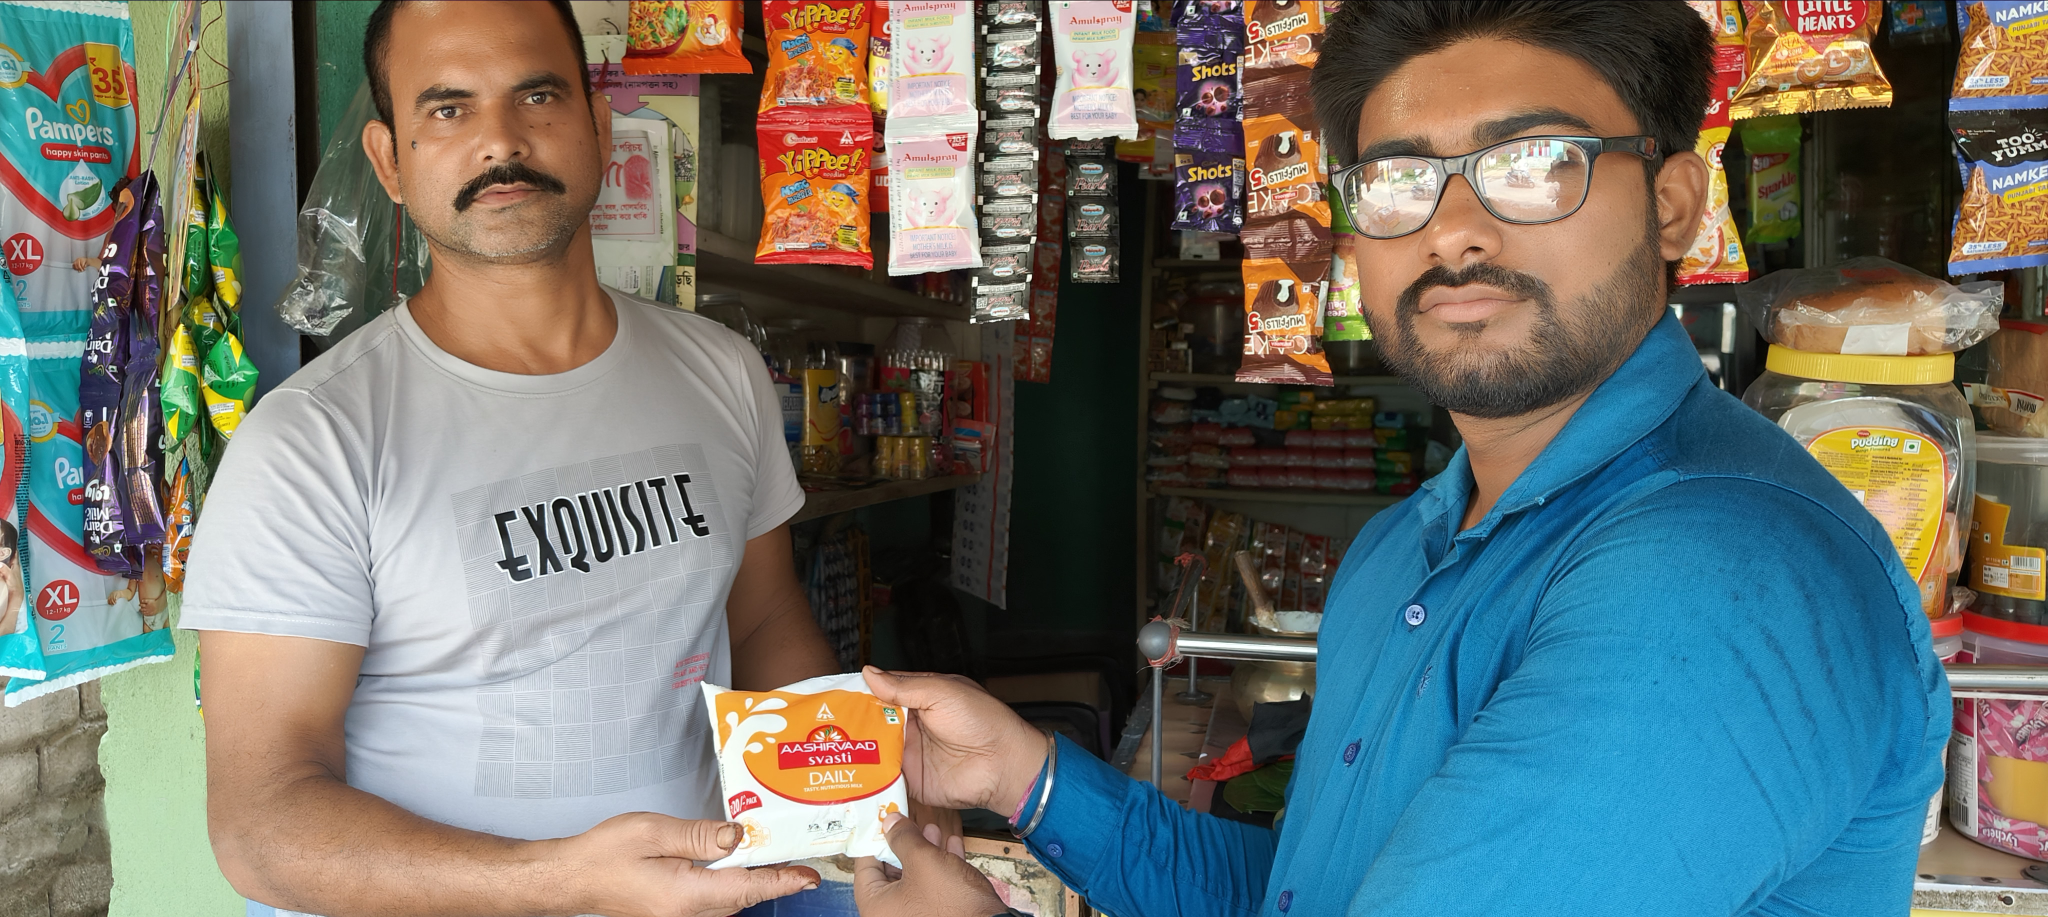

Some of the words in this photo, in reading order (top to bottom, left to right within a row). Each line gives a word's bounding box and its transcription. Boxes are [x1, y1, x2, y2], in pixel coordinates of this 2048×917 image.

[903, 2, 956, 13] Amulspray
[1069, 16, 1122, 26] Amulspray
[1797, 15, 1856, 33] HEARTS
[1191, 62, 1237, 82] Shots
[25, 107, 114, 147] Pampers
[1996, 133, 2035, 148] TOO
[46, 148, 72, 158] happy
[73, 149, 89, 158] skin
[90, 151, 108, 160] pants
[903, 154, 958, 164] Amulspray
[1188, 164, 1232, 182] Shots
[10, 239, 41, 261] XL
[16, 280, 28, 301] 2
[85, 507, 110, 521] Milk
[84, 520, 113, 534] Dairy
[494, 472, 711, 584] EXQUISITE
[45, 584, 78, 608] XL
[46, 608, 62, 616] 12-17
[63, 606, 71, 614] kg
[49, 624, 65, 645] 2
[780, 741, 877, 754] AASHIRVAAD
[808, 752, 852, 765] svasti
[809, 769, 857, 786] DAILY
